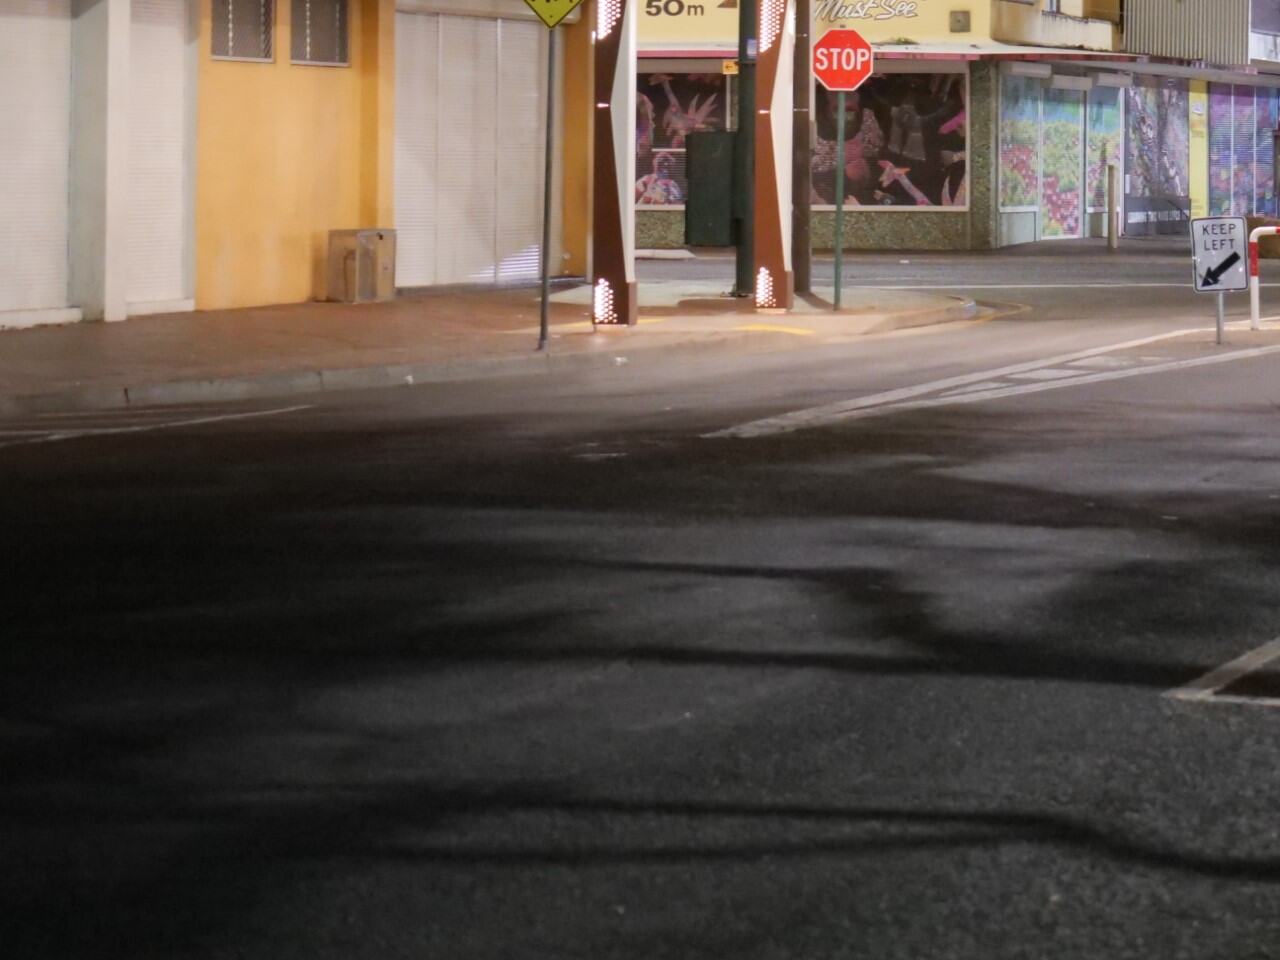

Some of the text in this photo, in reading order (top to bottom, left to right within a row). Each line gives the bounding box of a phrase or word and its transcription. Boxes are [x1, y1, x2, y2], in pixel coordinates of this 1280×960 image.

[815, 48, 870, 70] STOP
[1202, 223, 1236, 235] KEEP
[1204, 238, 1235, 251] LEFT
